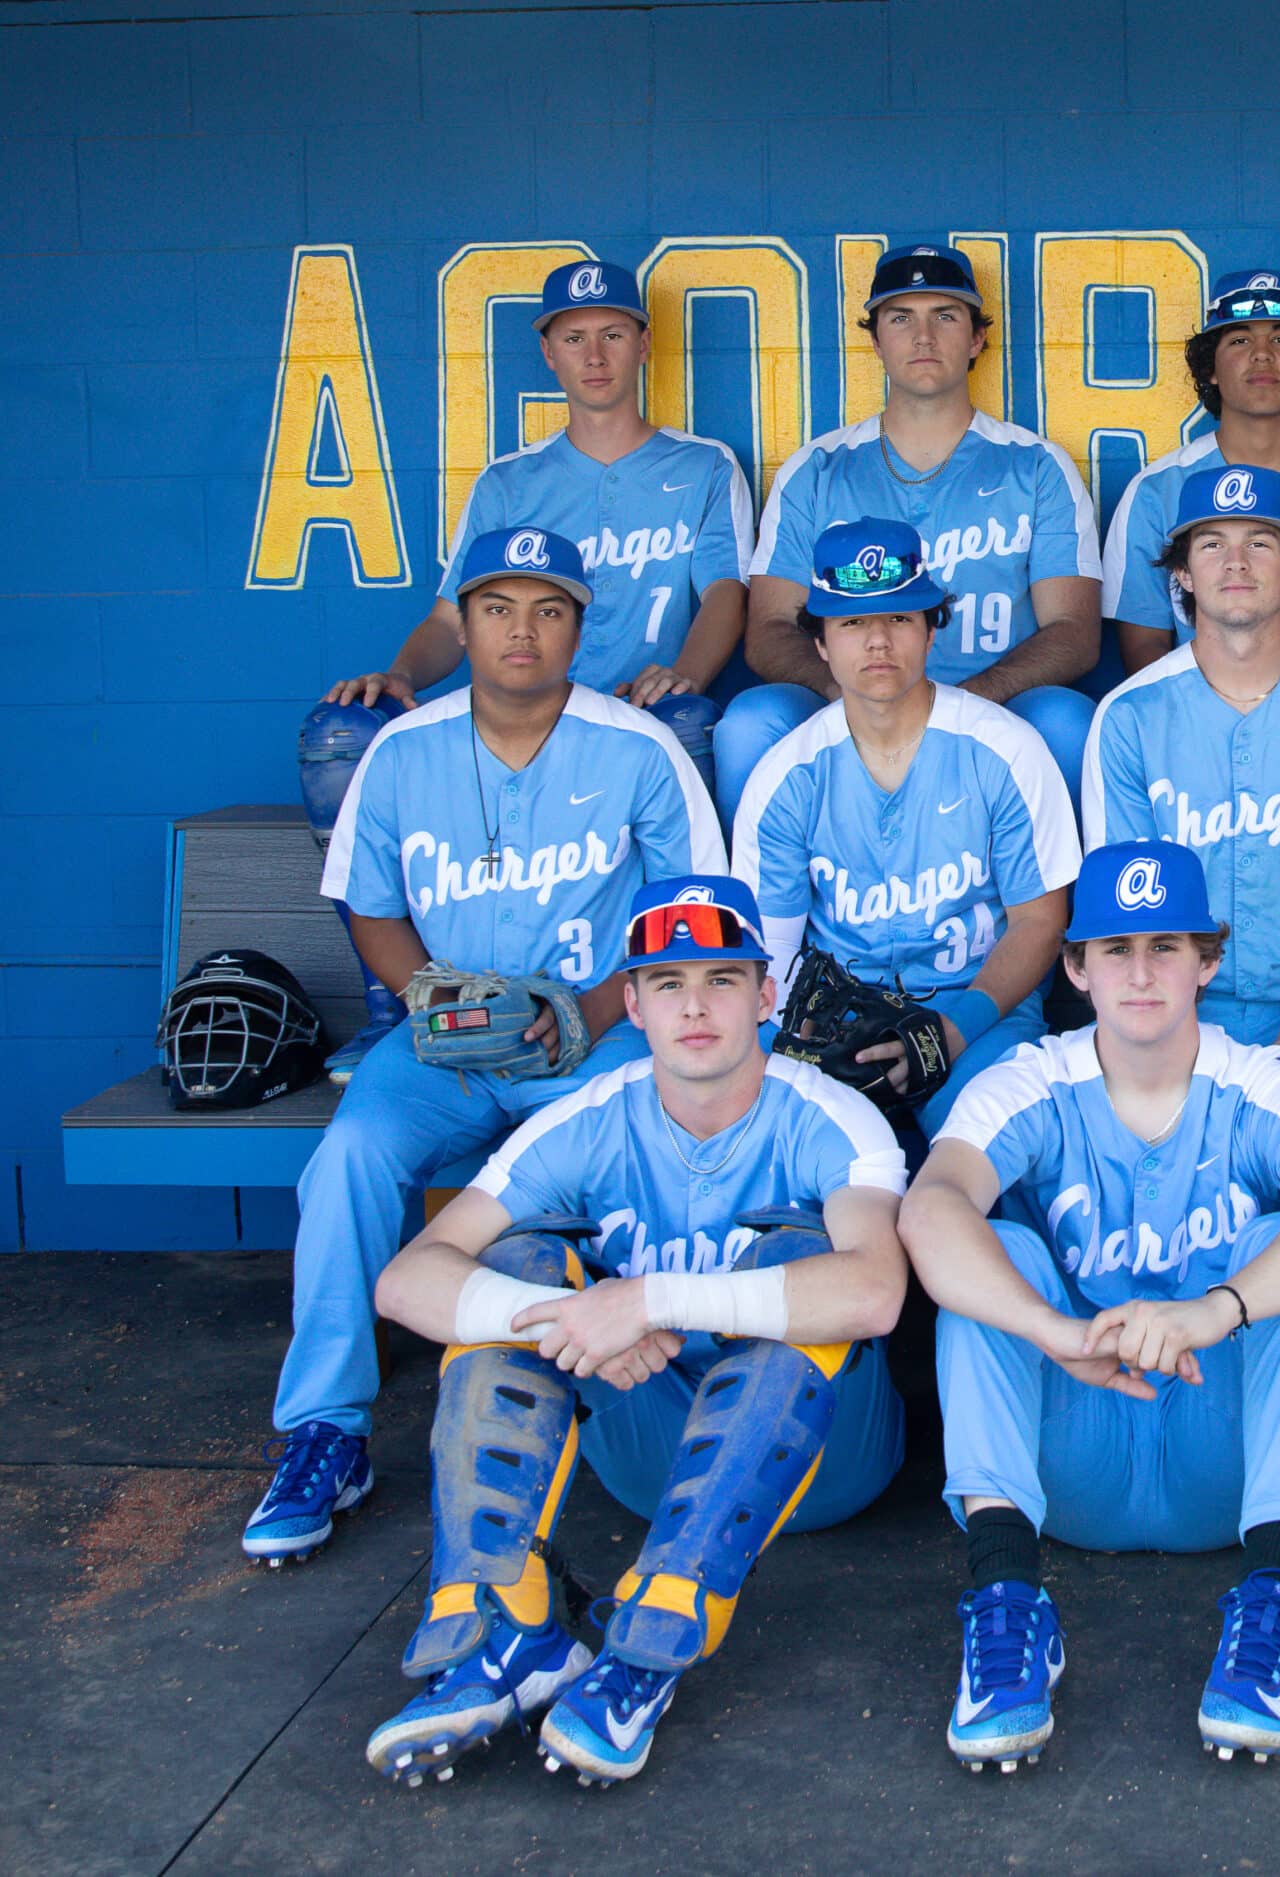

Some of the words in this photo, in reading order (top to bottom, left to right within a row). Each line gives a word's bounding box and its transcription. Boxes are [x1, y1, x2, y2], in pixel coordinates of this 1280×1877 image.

[568, 264, 608, 302] a
[1213, 469, 1257, 512] a
[504, 529, 550, 569] a
[953, 592, 1012, 654] 19
[809, 845, 991, 926] Charger
[1115, 857, 1167, 911] a
[558, 918, 594, 982] 3
[933, 902, 998, 973] 34
